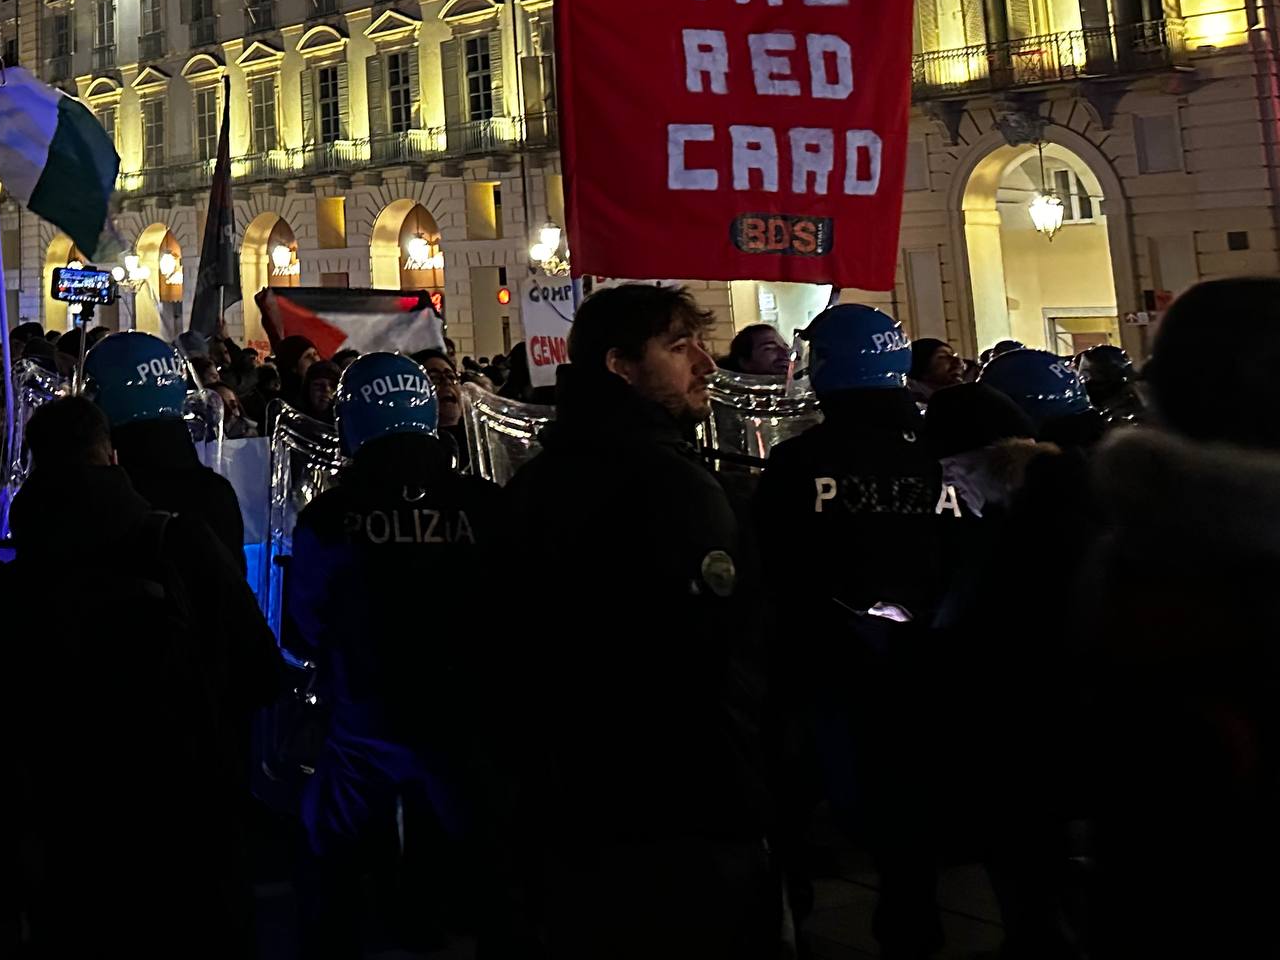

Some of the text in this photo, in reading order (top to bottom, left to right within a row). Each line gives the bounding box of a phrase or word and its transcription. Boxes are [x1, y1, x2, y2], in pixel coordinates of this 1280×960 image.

[680, 27, 855, 101] RED
[665, 121, 884, 198] CARD
[742, 217, 817, 253] BDS
[360, 373, 431, 404] POLIZIA
